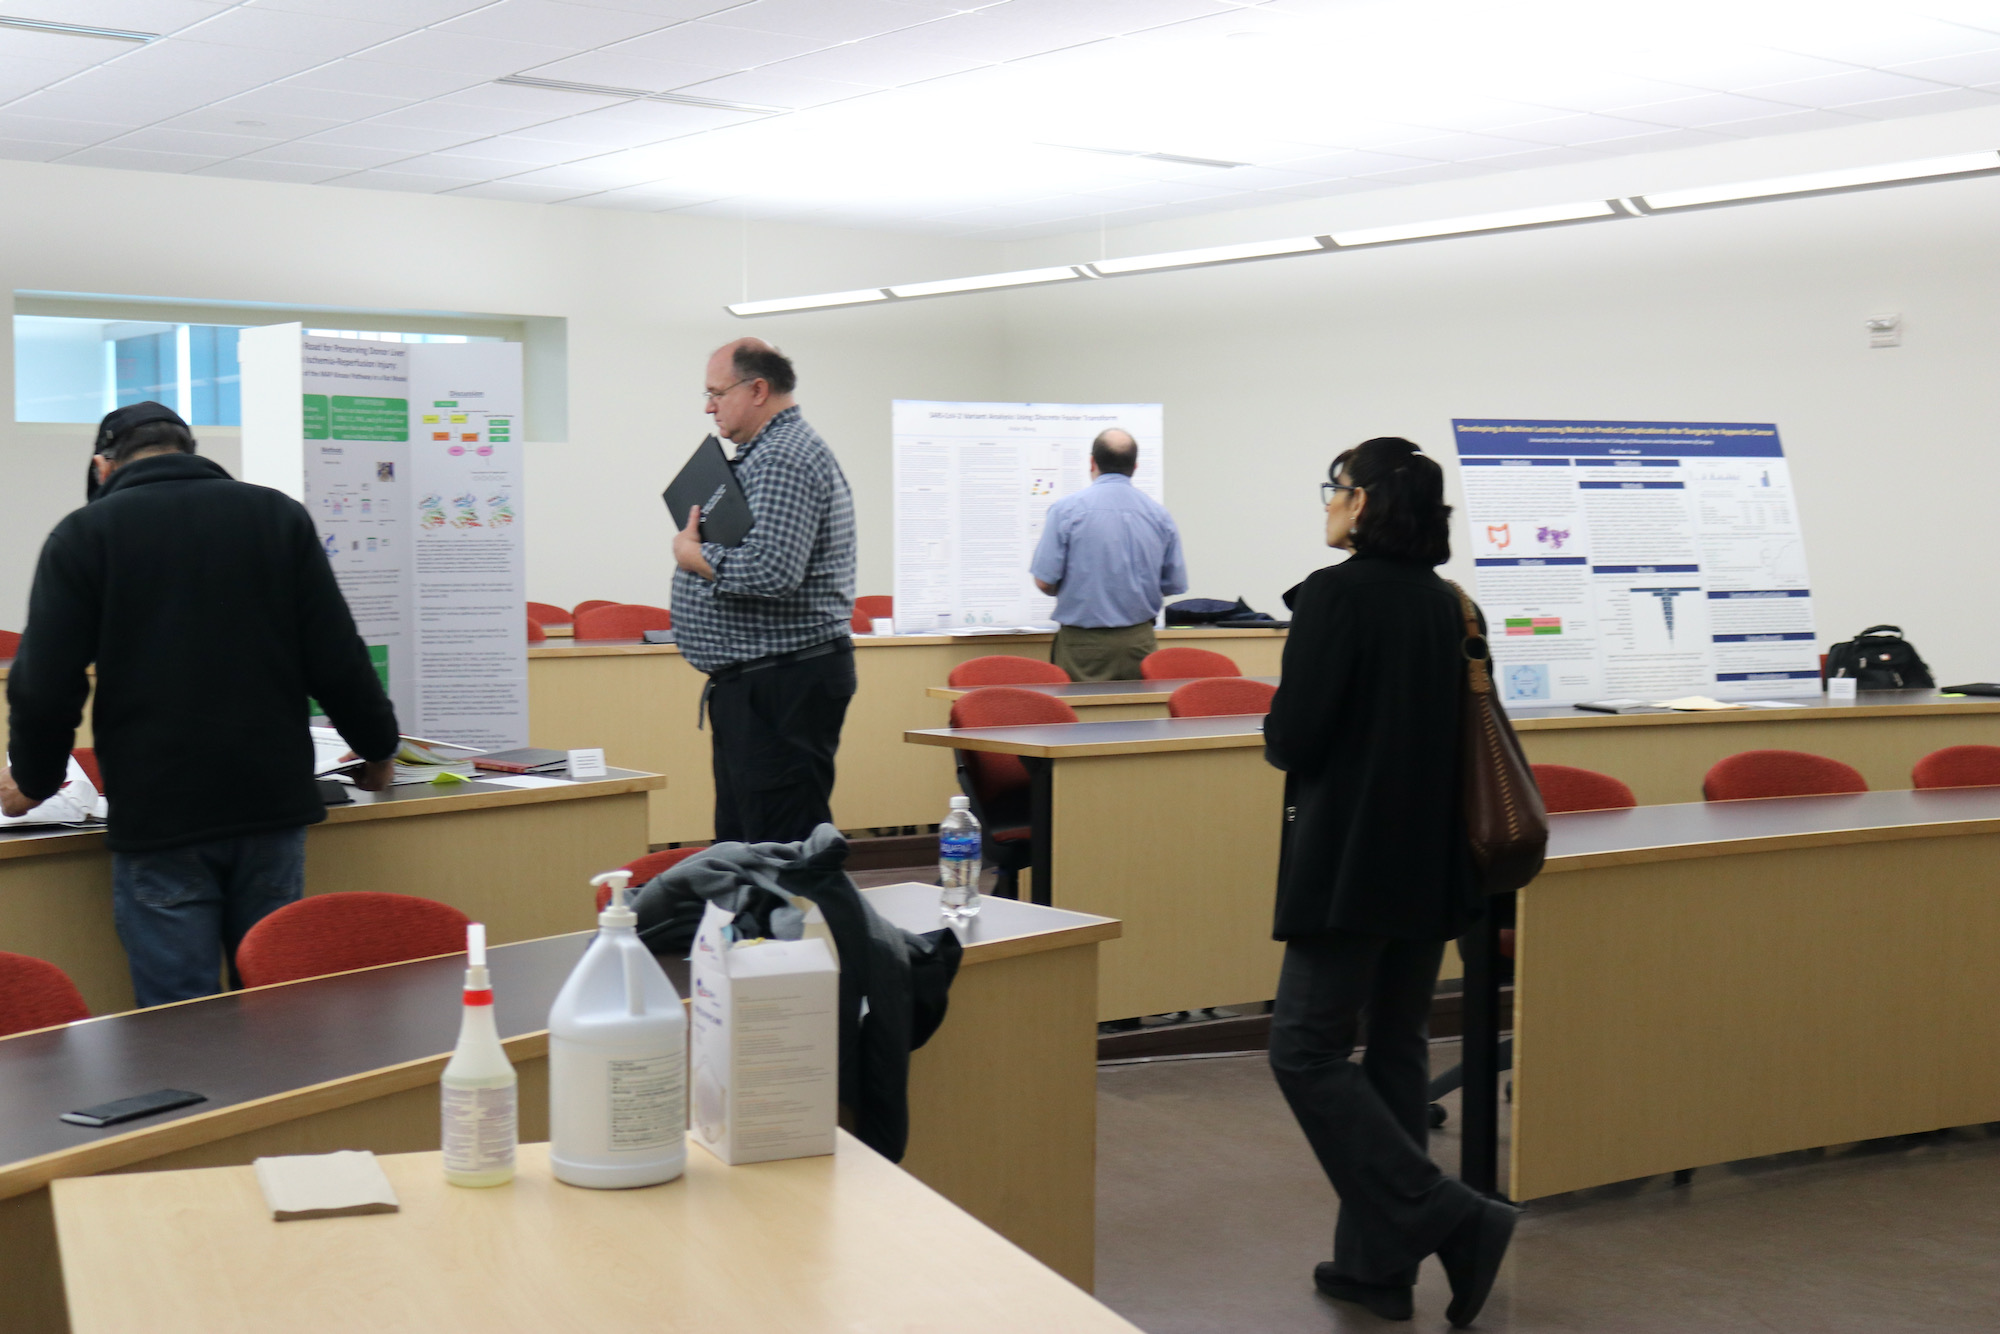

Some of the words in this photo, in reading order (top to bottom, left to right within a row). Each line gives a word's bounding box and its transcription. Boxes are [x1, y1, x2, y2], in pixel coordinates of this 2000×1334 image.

[304, 342, 321, 351] Road
[334, 344, 368, 356] Preserving
[370, 347, 388, 356] Donor
[390, 348, 406, 357] Liver
[305, 356, 374, 368] Ischemia-Reperfusion
[988, 413, 1015, 421] Analysis
[1016, 414, 1034, 422] Using
[1456, 425, 1498, 434] Developing
[1536, 426, 1564, 434] Learning
[1618, 427, 1668, 435] Complications
[1682, 428, 1706, 436] Surgery
[1752, 428, 1775, 436] Cancer
